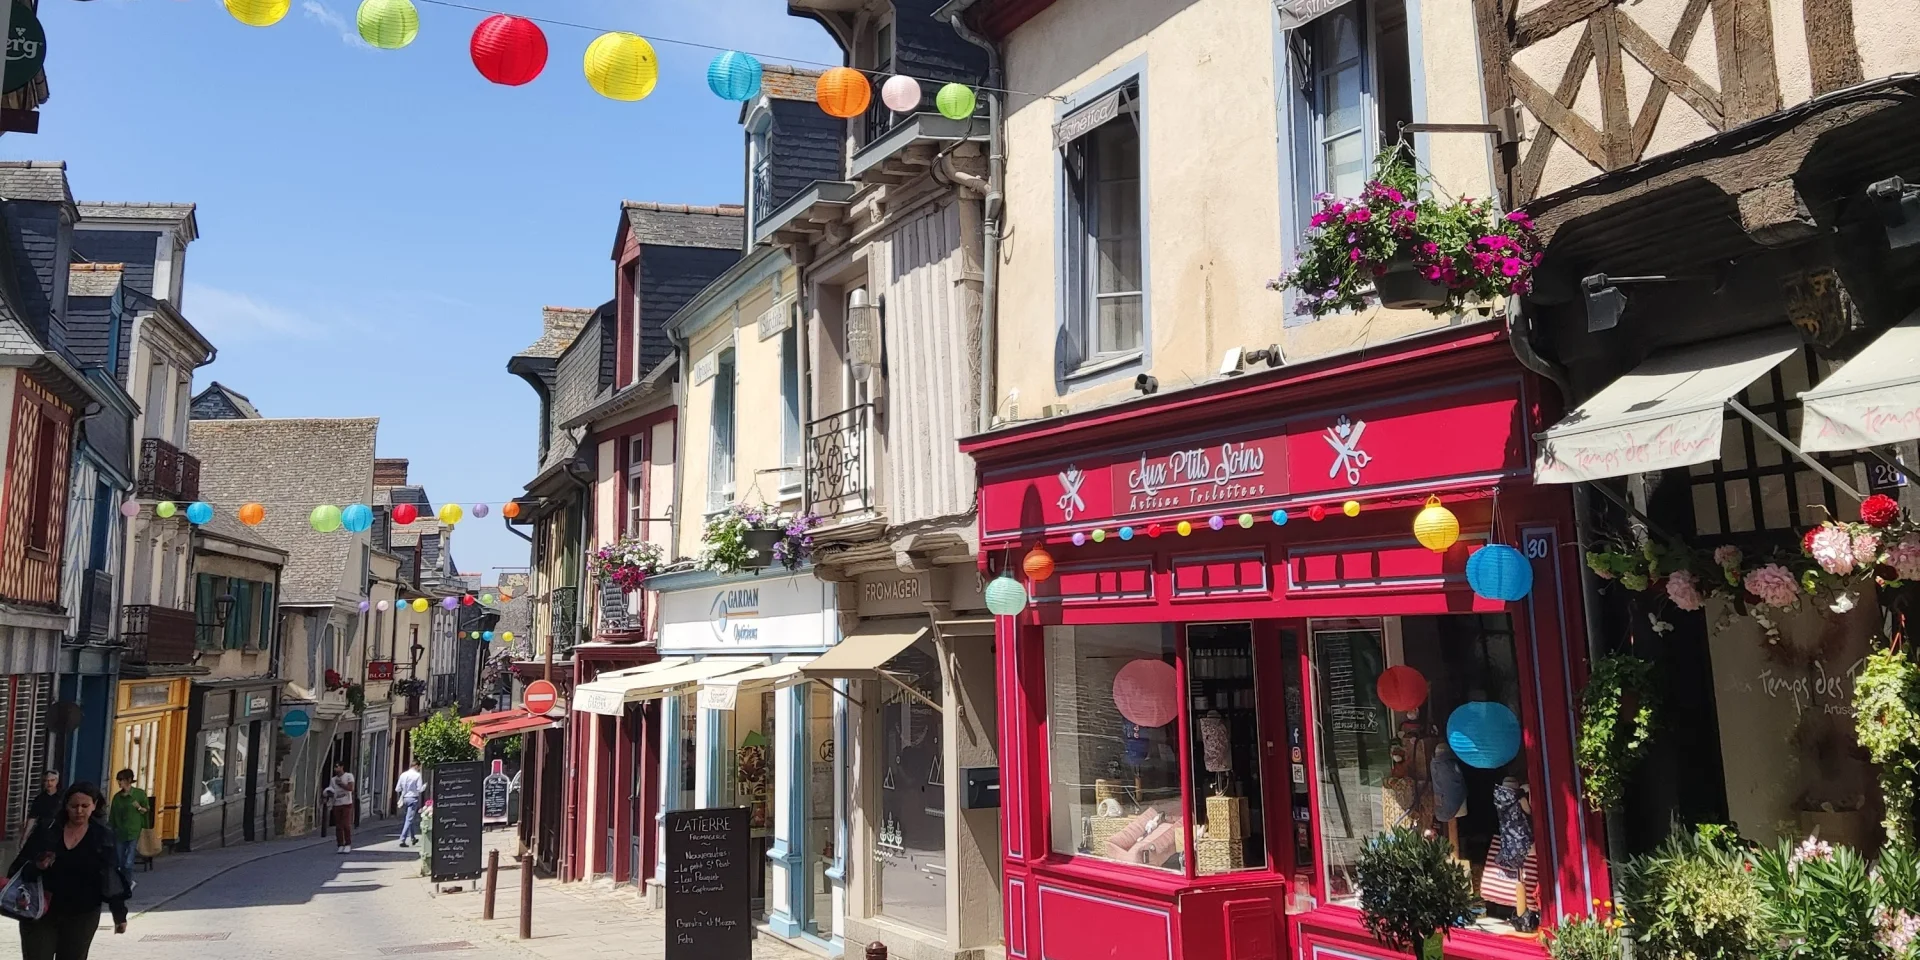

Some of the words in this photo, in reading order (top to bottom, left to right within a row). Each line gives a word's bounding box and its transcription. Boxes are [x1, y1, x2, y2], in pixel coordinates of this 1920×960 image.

[1574, 446, 1620, 472] temps
[1625, 431, 1649, 462] des
[1128, 450, 1168, 496] Aux
[1214, 442, 1264, 486] Soins
[1875, 463, 1898, 485] 28
[1129, 494, 1180, 512] Artisan
[1189, 483, 1266, 504] Toiletteur
[1528, 538, 1548, 559] 30
[727, 587, 759, 609] GARDAN
[1758, 668, 1810, 716] temps
[1814, 659, 1844, 700] des
